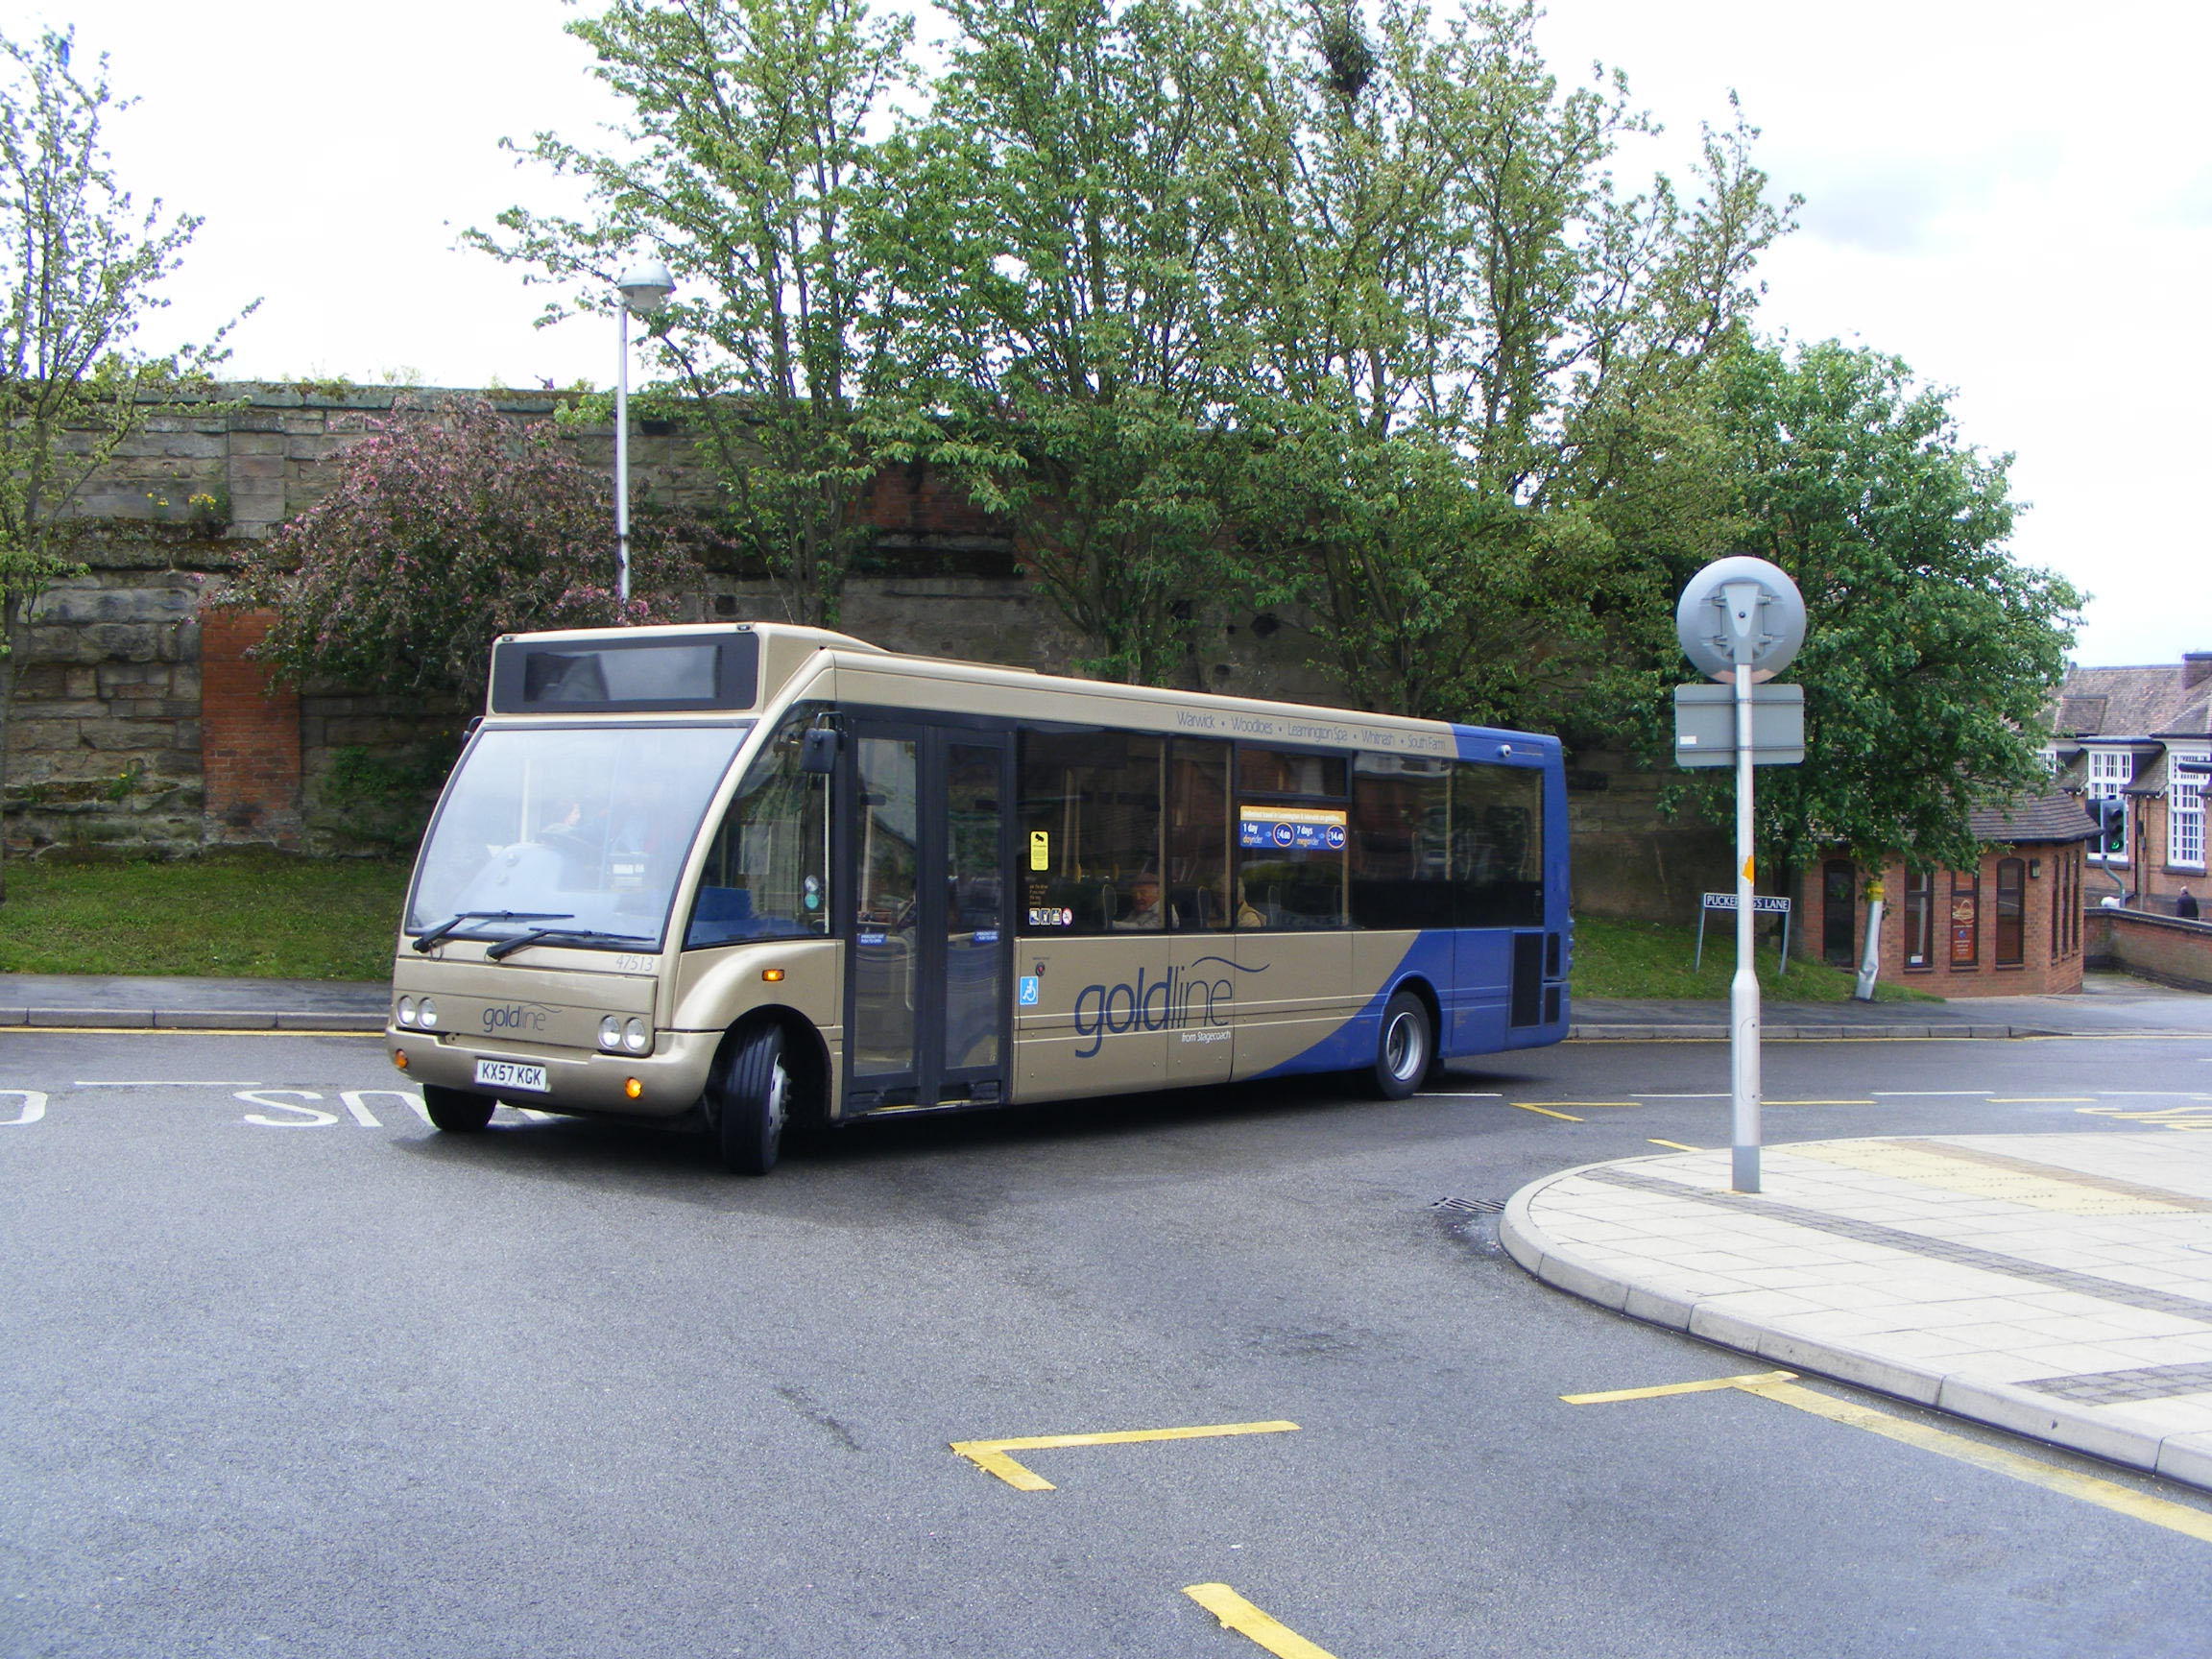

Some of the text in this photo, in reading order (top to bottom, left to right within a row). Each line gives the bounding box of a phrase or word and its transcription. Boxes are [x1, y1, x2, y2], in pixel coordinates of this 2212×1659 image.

[1175, 710, 1215, 730] Warwick
[1287, 722, 1334, 743] Leamington
[1334, 727, 1348, 744] Spa
[1407, 734, 1428, 750] South
[1429, 736, 1446, 751] Farm
[1247, 823, 1259, 835] day
[1301, 826, 1313, 837] days
[1243, 834, 1262, 845] dayrider
[1765, 899, 1788, 909] LANE
[615, 954, 654, 972] 47513
[482, 1004, 546, 1033] goldline
[1073, 966, 1233, 1059] goldline
[1181, 1029, 1232, 1045] from Stagecoach
[482, 1062, 541, 1086] KX57 KGK
